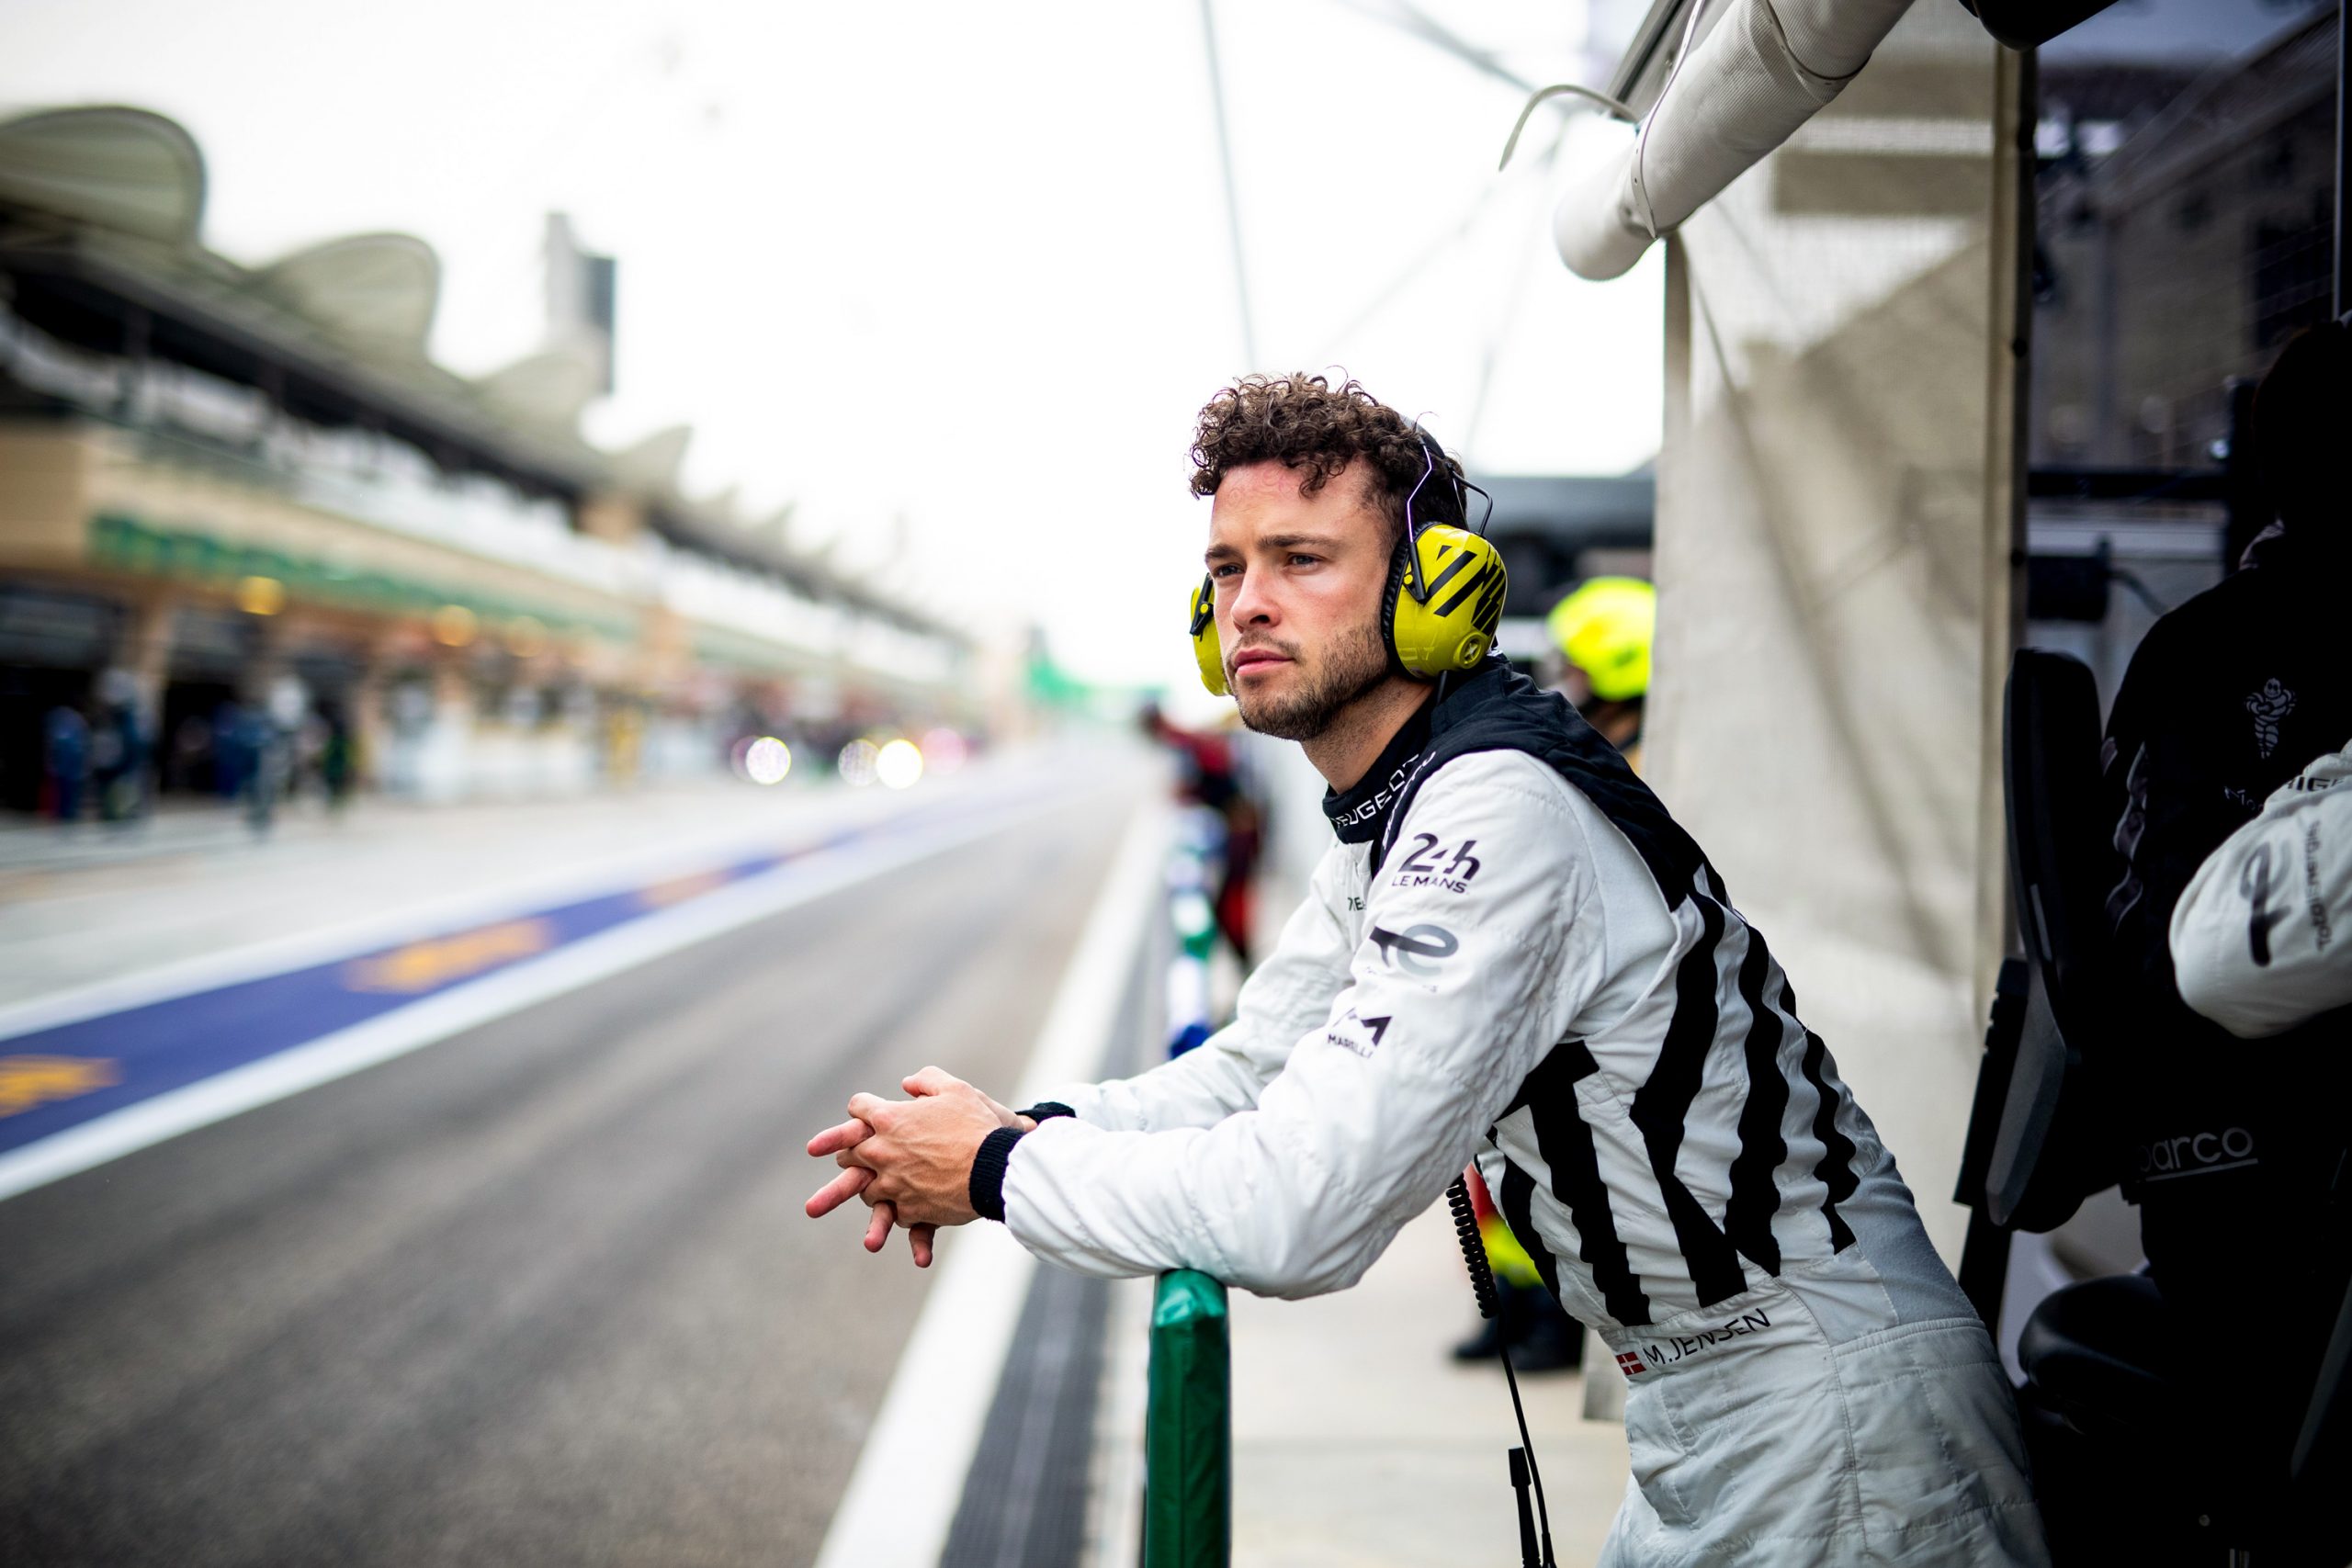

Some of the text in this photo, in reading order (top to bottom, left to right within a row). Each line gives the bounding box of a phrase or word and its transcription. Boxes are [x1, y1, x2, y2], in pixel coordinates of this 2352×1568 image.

[1397, 832, 1481, 881] 24h
[1392, 875, 1468, 894] LE MANS
[1643, 1308, 1771, 1365] M.JENSEN
